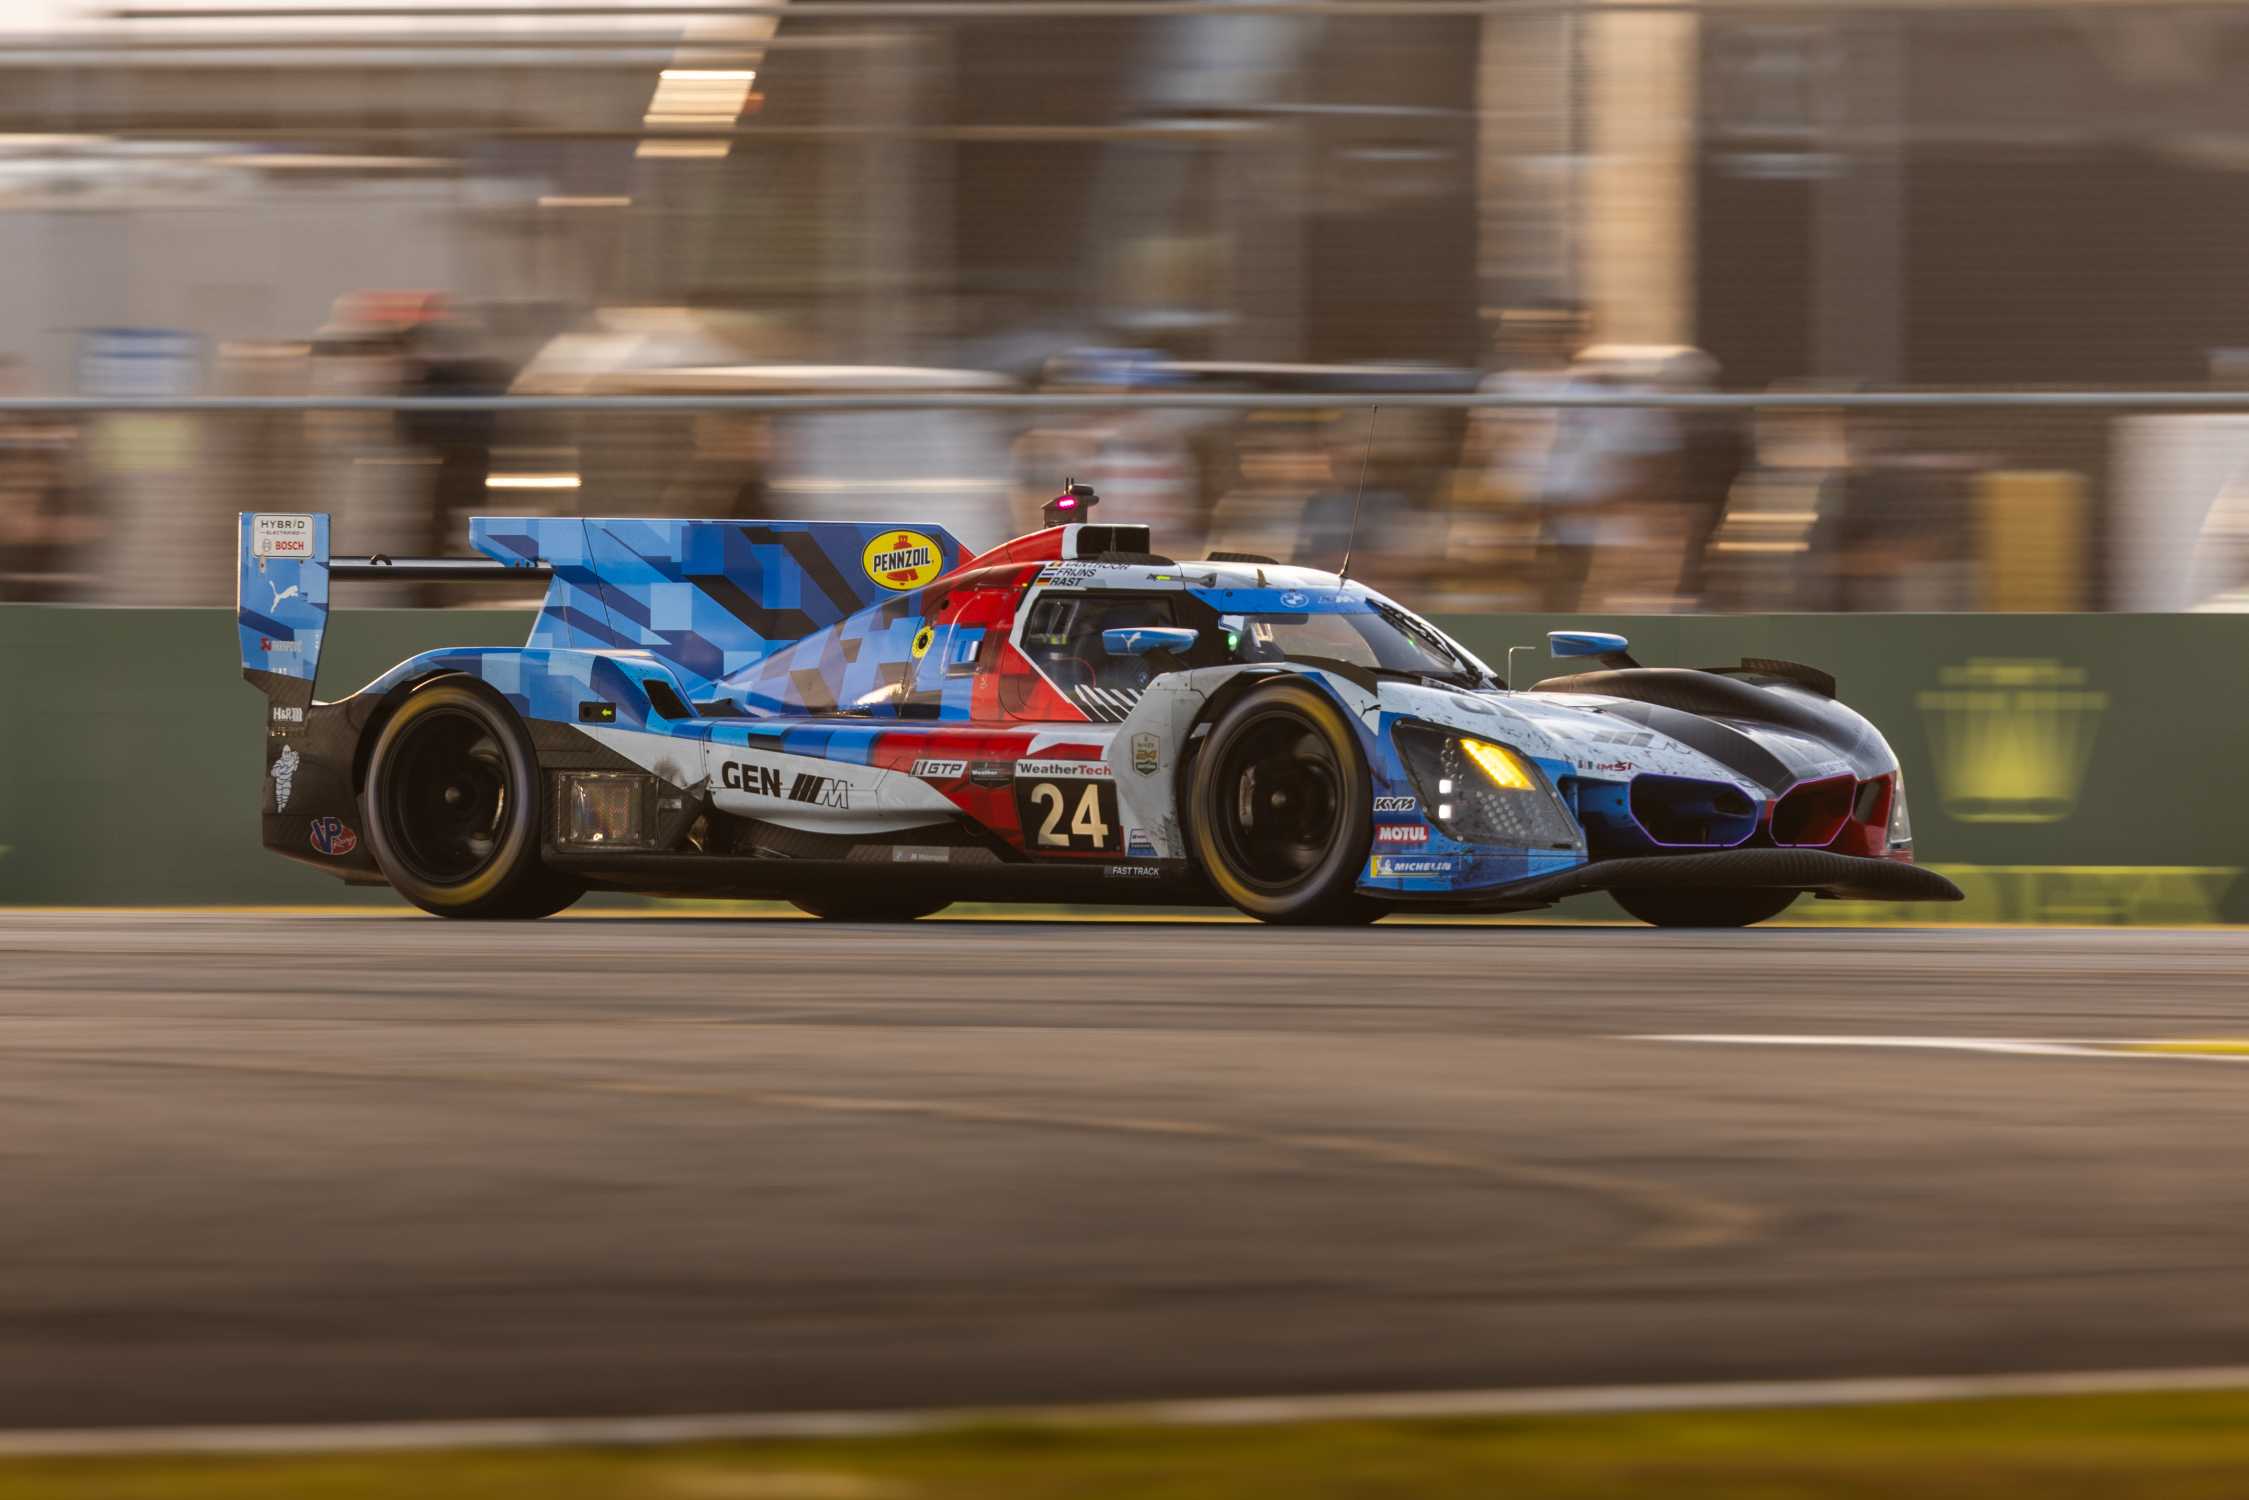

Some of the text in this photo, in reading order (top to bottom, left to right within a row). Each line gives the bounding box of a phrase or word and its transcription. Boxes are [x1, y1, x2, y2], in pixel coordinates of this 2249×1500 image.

[261, 520, 305, 529] HYBRID
[275, 541, 304, 551] BOSCH
[873, 547, 931, 573] PENNZOIL
[1049, 577, 1084, 587] RAST
[927, 763, 963, 775] GTP
[1018, 762, 1113, 776] WeatherTech
[721, 760, 782, 799] GEN
[1373, 796, 1416, 811] KYB
[1031, 783, 1110, 848] 24
[1379, 826, 1427, 841] MOTUL
[1112, 866, 1160, 877] FAST TRACK
[1394, 862, 1452, 872] MICHELIN
